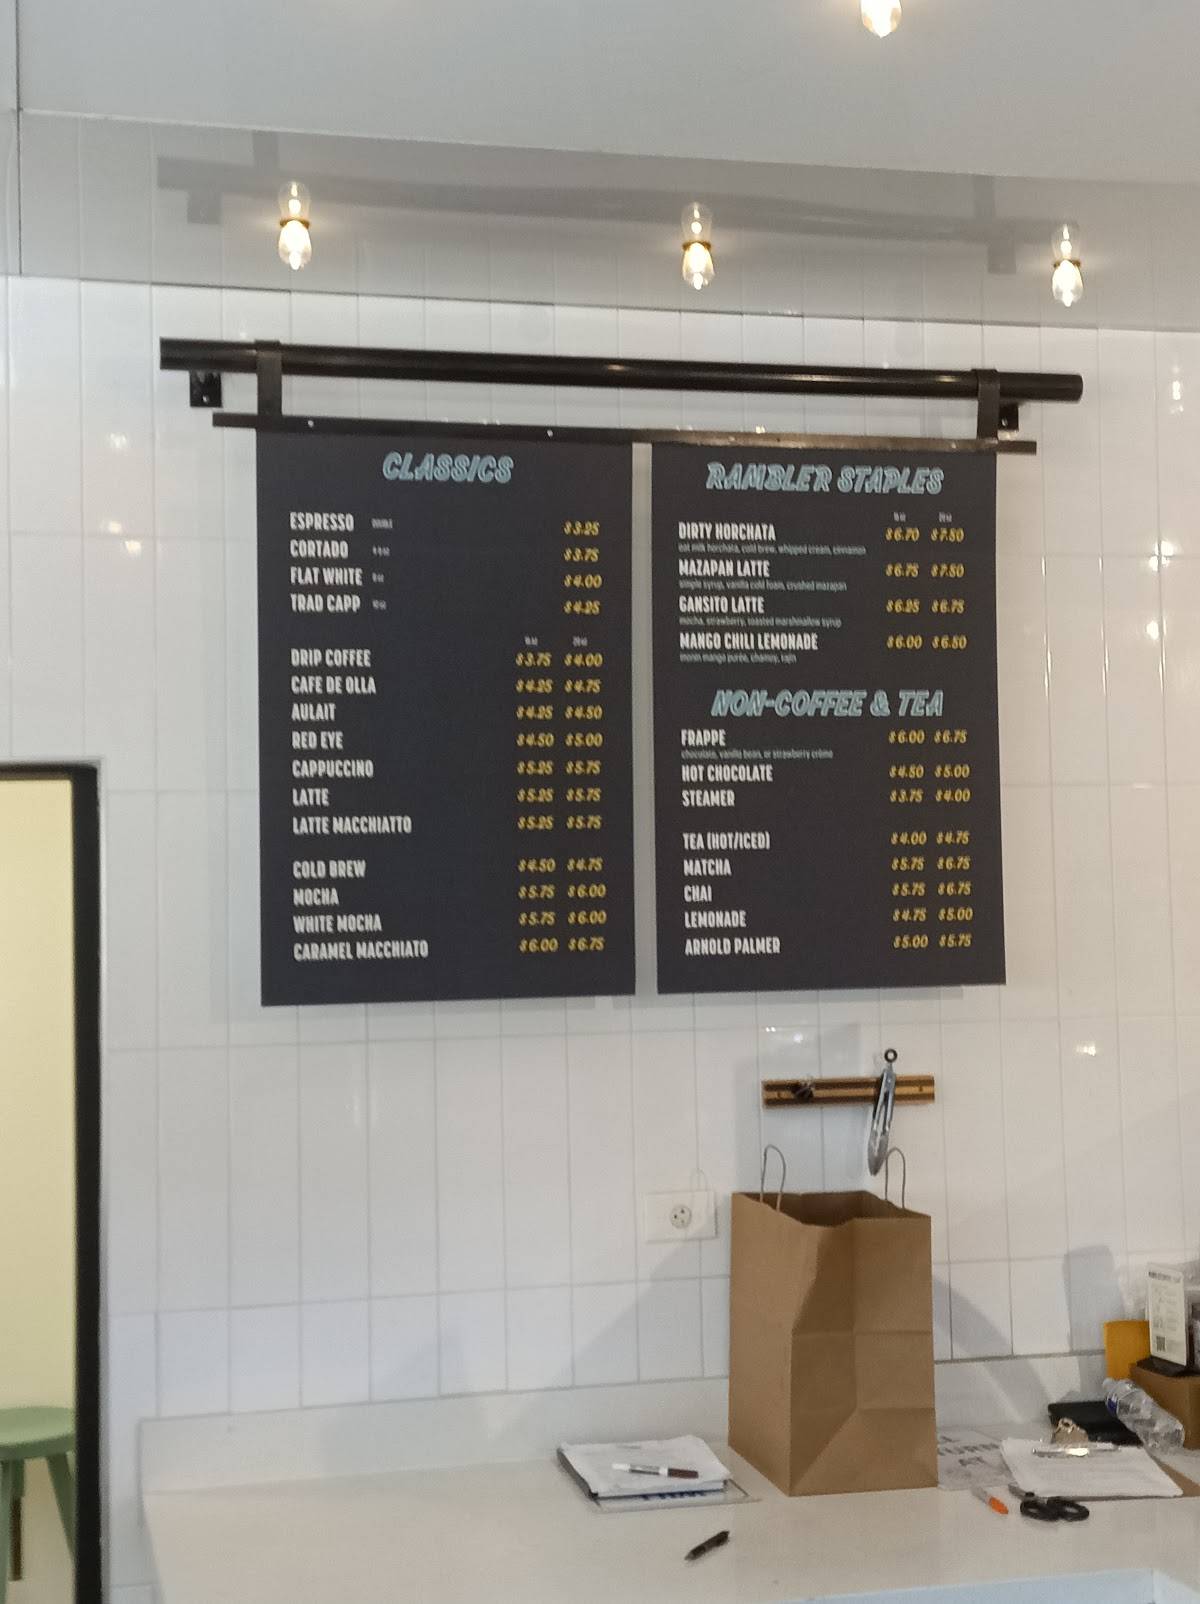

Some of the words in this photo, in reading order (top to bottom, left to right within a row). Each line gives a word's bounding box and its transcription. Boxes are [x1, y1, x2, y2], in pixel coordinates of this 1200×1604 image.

[383, 452, 514, 483] CLASSICS
[706, 462, 832, 492] RAMBLER
[837, 466, 944, 494] STAPLES
[290, 512, 354, 531] ESPRESSO
[679, 522, 712, 539] DIRTY
[715, 523, 775, 540] HORCHATA
[290, 539, 348, 558] CORTADO
[291, 567, 319, 584] FLAT
[323, 568, 362, 585] WHITE
[679, 559, 733, 576] MAZAPAN
[737, 560, 769, 577] LATTE
[291, 594, 323, 612] TRAD
[327, 595, 360, 612] CAPP
[679, 596, 728, 613] GANSITO
[732, 596, 764, 613] LATTE
[680, 632, 721, 649] MANGO
[724, 632, 754, 649] CHILI
[758, 633, 818, 650] LEMONADE
[291, 649, 322, 666] DRIP
[326, 649, 371, 667] COFFEE
[291, 676, 322, 694] CAFE
[326, 676, 342, 694] DE
[346, 676, 376, 694] OLLA
[292, 703, 335, 721] AULAIT
[711, 689, 867, 717] NON-COFFEE
[870, 690, 890, 716] &
[899, 690, 943, 716] TEA
[292, 731, 317, 749] RED
[321, 731, 343, 749] EYE
[681, 729, 725, 746] FRAPPE
[292, 760, 373, 778] CAPPUCCINO
[682, 765, 704, 782] HOT
[707, 765, 773, 782] CHOCOLATE
[293, 788, 329, 806] LATTE
[682, 790, 734, 806] STEAMER
[293, 816, 329, 834] LATTE
[333, 816, 411, 834] MACCHIATTO
[683, 833, 704, 850] TEA
[707, 832, 770, 849] (HOT/ICED)
[293, 861, 326, 878] COLD
[329, 860, 366, 878] BREW
[684, 859, 731, 876] MATCHA
[294, 888, 339, 905] MOCHA
[684, 885, 712, 902] CHAI
[293, 915, 333, 933] WHITE
[337, 914, 382, 932] MOCHA
[685, 910, 746, 928] LEMONADE
[294, 942, 353, 961] CARAMEL
[356, 940, 428, 958] MACCHIATO
[685, 938, 731, 955] ARNOLD
[734, 937, 780, 954] PALMER
